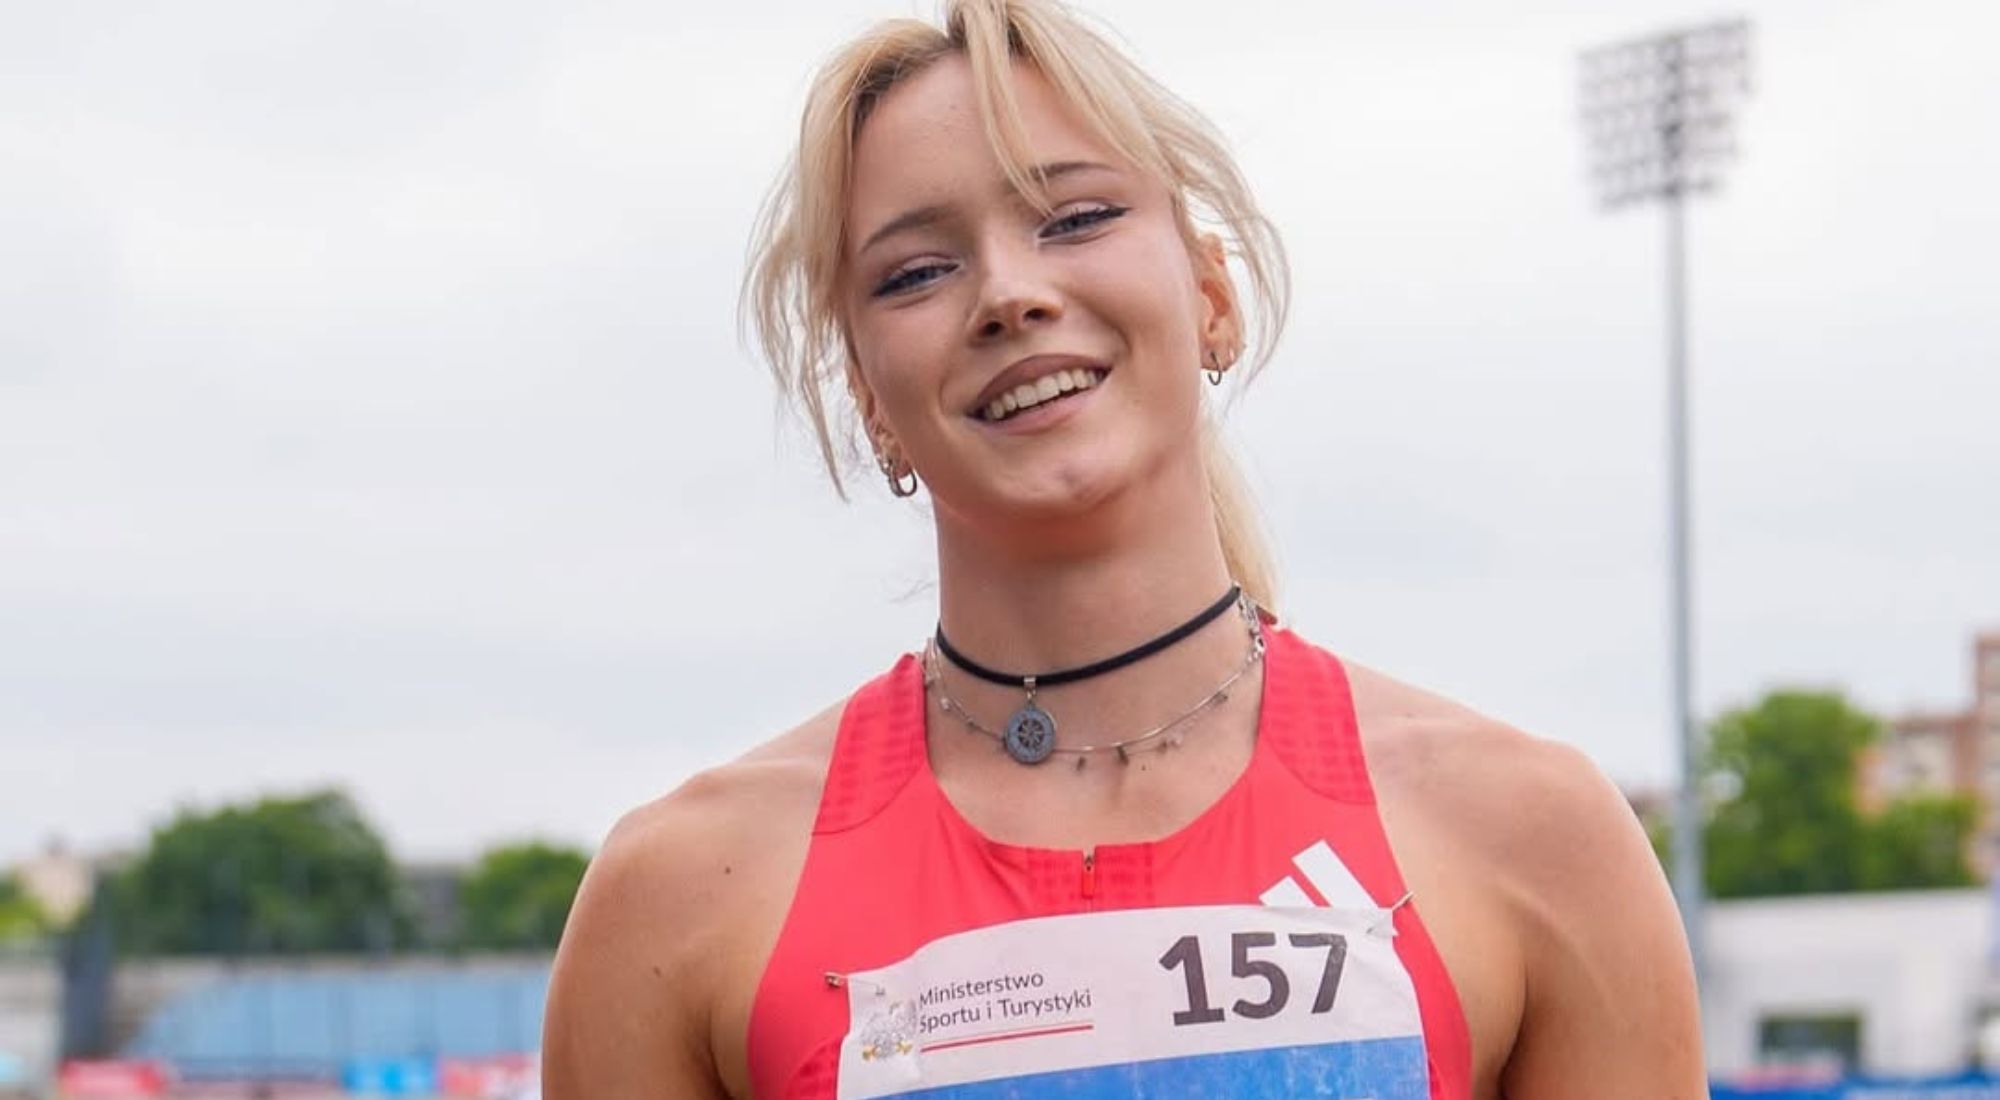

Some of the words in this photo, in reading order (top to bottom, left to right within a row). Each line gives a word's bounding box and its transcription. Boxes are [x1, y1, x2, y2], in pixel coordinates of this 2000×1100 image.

[920, 972, 1044, 1009] Ministerstwo
[1159, 932, 1347, 1026] 157
[986, 1001, 992, 1020] i
[997, 989, 1092, 1018] Turystyki
